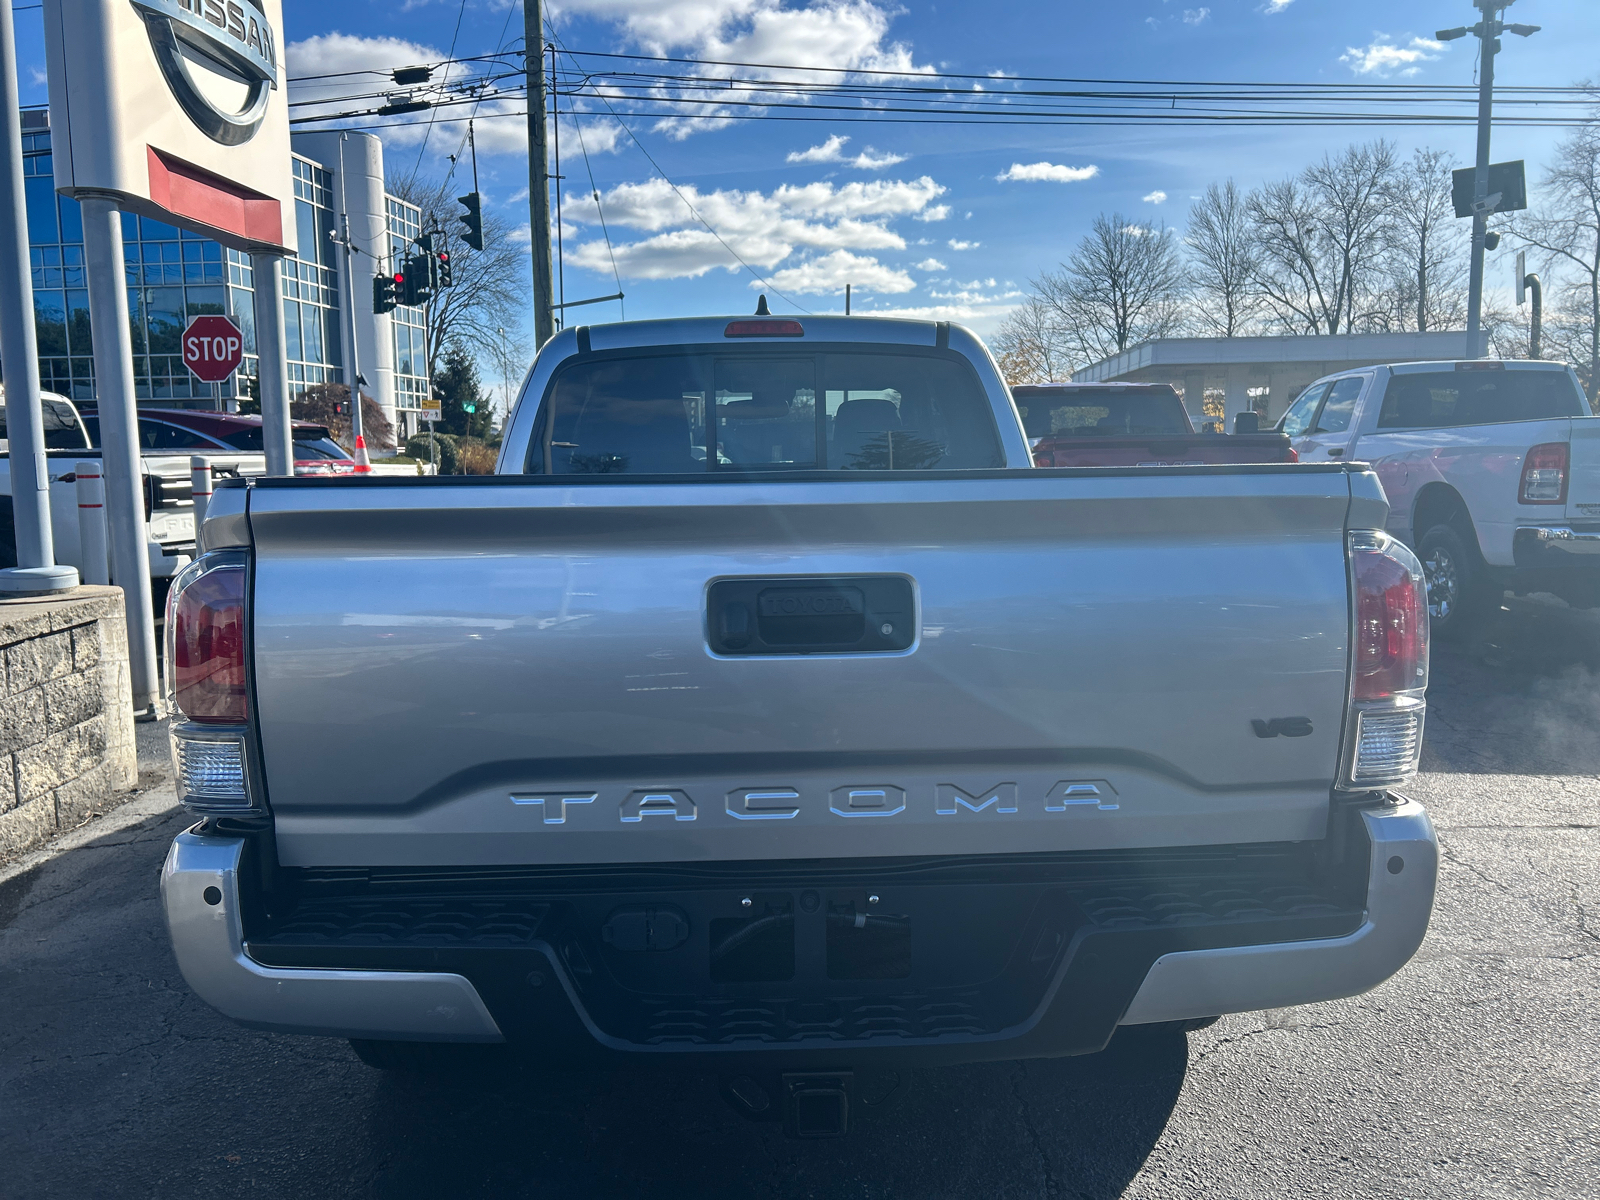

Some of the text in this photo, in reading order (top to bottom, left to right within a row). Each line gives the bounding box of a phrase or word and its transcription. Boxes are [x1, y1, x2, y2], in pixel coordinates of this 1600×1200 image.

[165, 0, 277, 71] ISSAN
[187, 336, 240, 361] STOP
[768, 595, 857, 614] TOYOTA
[1250, 715, 1314, 739] V6
[509, 779, 1121, 825] TACOMA
